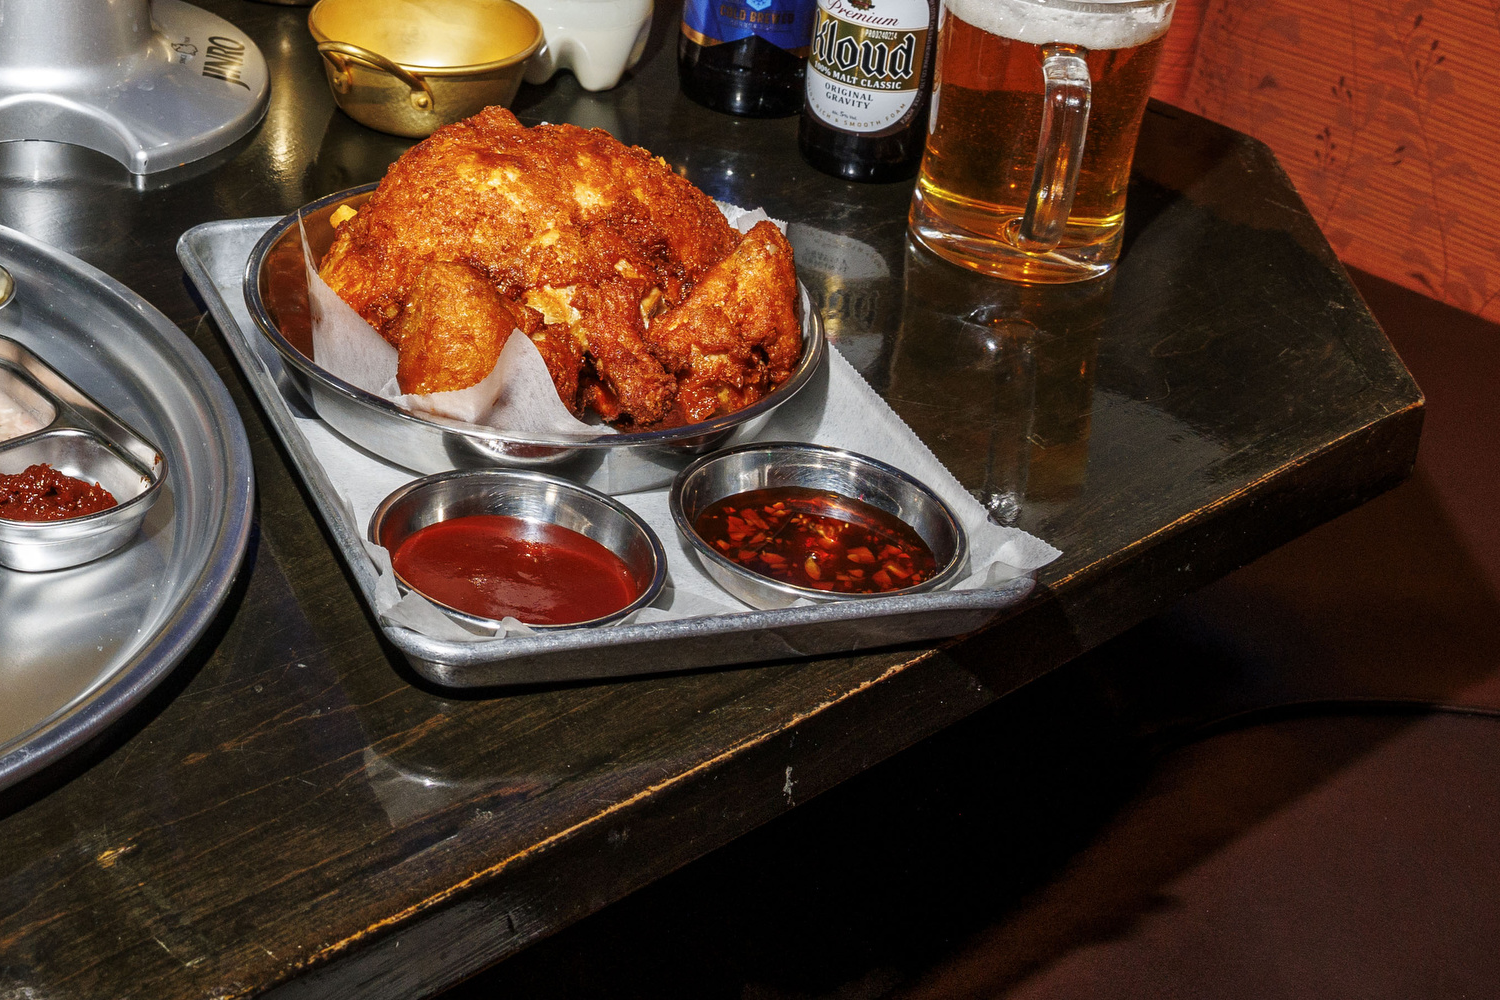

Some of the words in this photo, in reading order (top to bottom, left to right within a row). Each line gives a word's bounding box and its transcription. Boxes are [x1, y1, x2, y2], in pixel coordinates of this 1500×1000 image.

[720, 4, 746, 21] COLD
[749, 11, 796, 25] BREWED
[202, 36, 251, 91] JINRO
[814, 60, 832, 77] 100%
[832, 70, 859, 85] MALT
[860, 79, 902, 90] CLASSIC
[825, 82, 874, 102] ORIGINAL
[826, 91, 870, 109] GRAVITY
[816, 103, 831, 119] RICH
[843, 120, 881, 128] SMOOTH
[885, 103, 906, 121] FOAM
